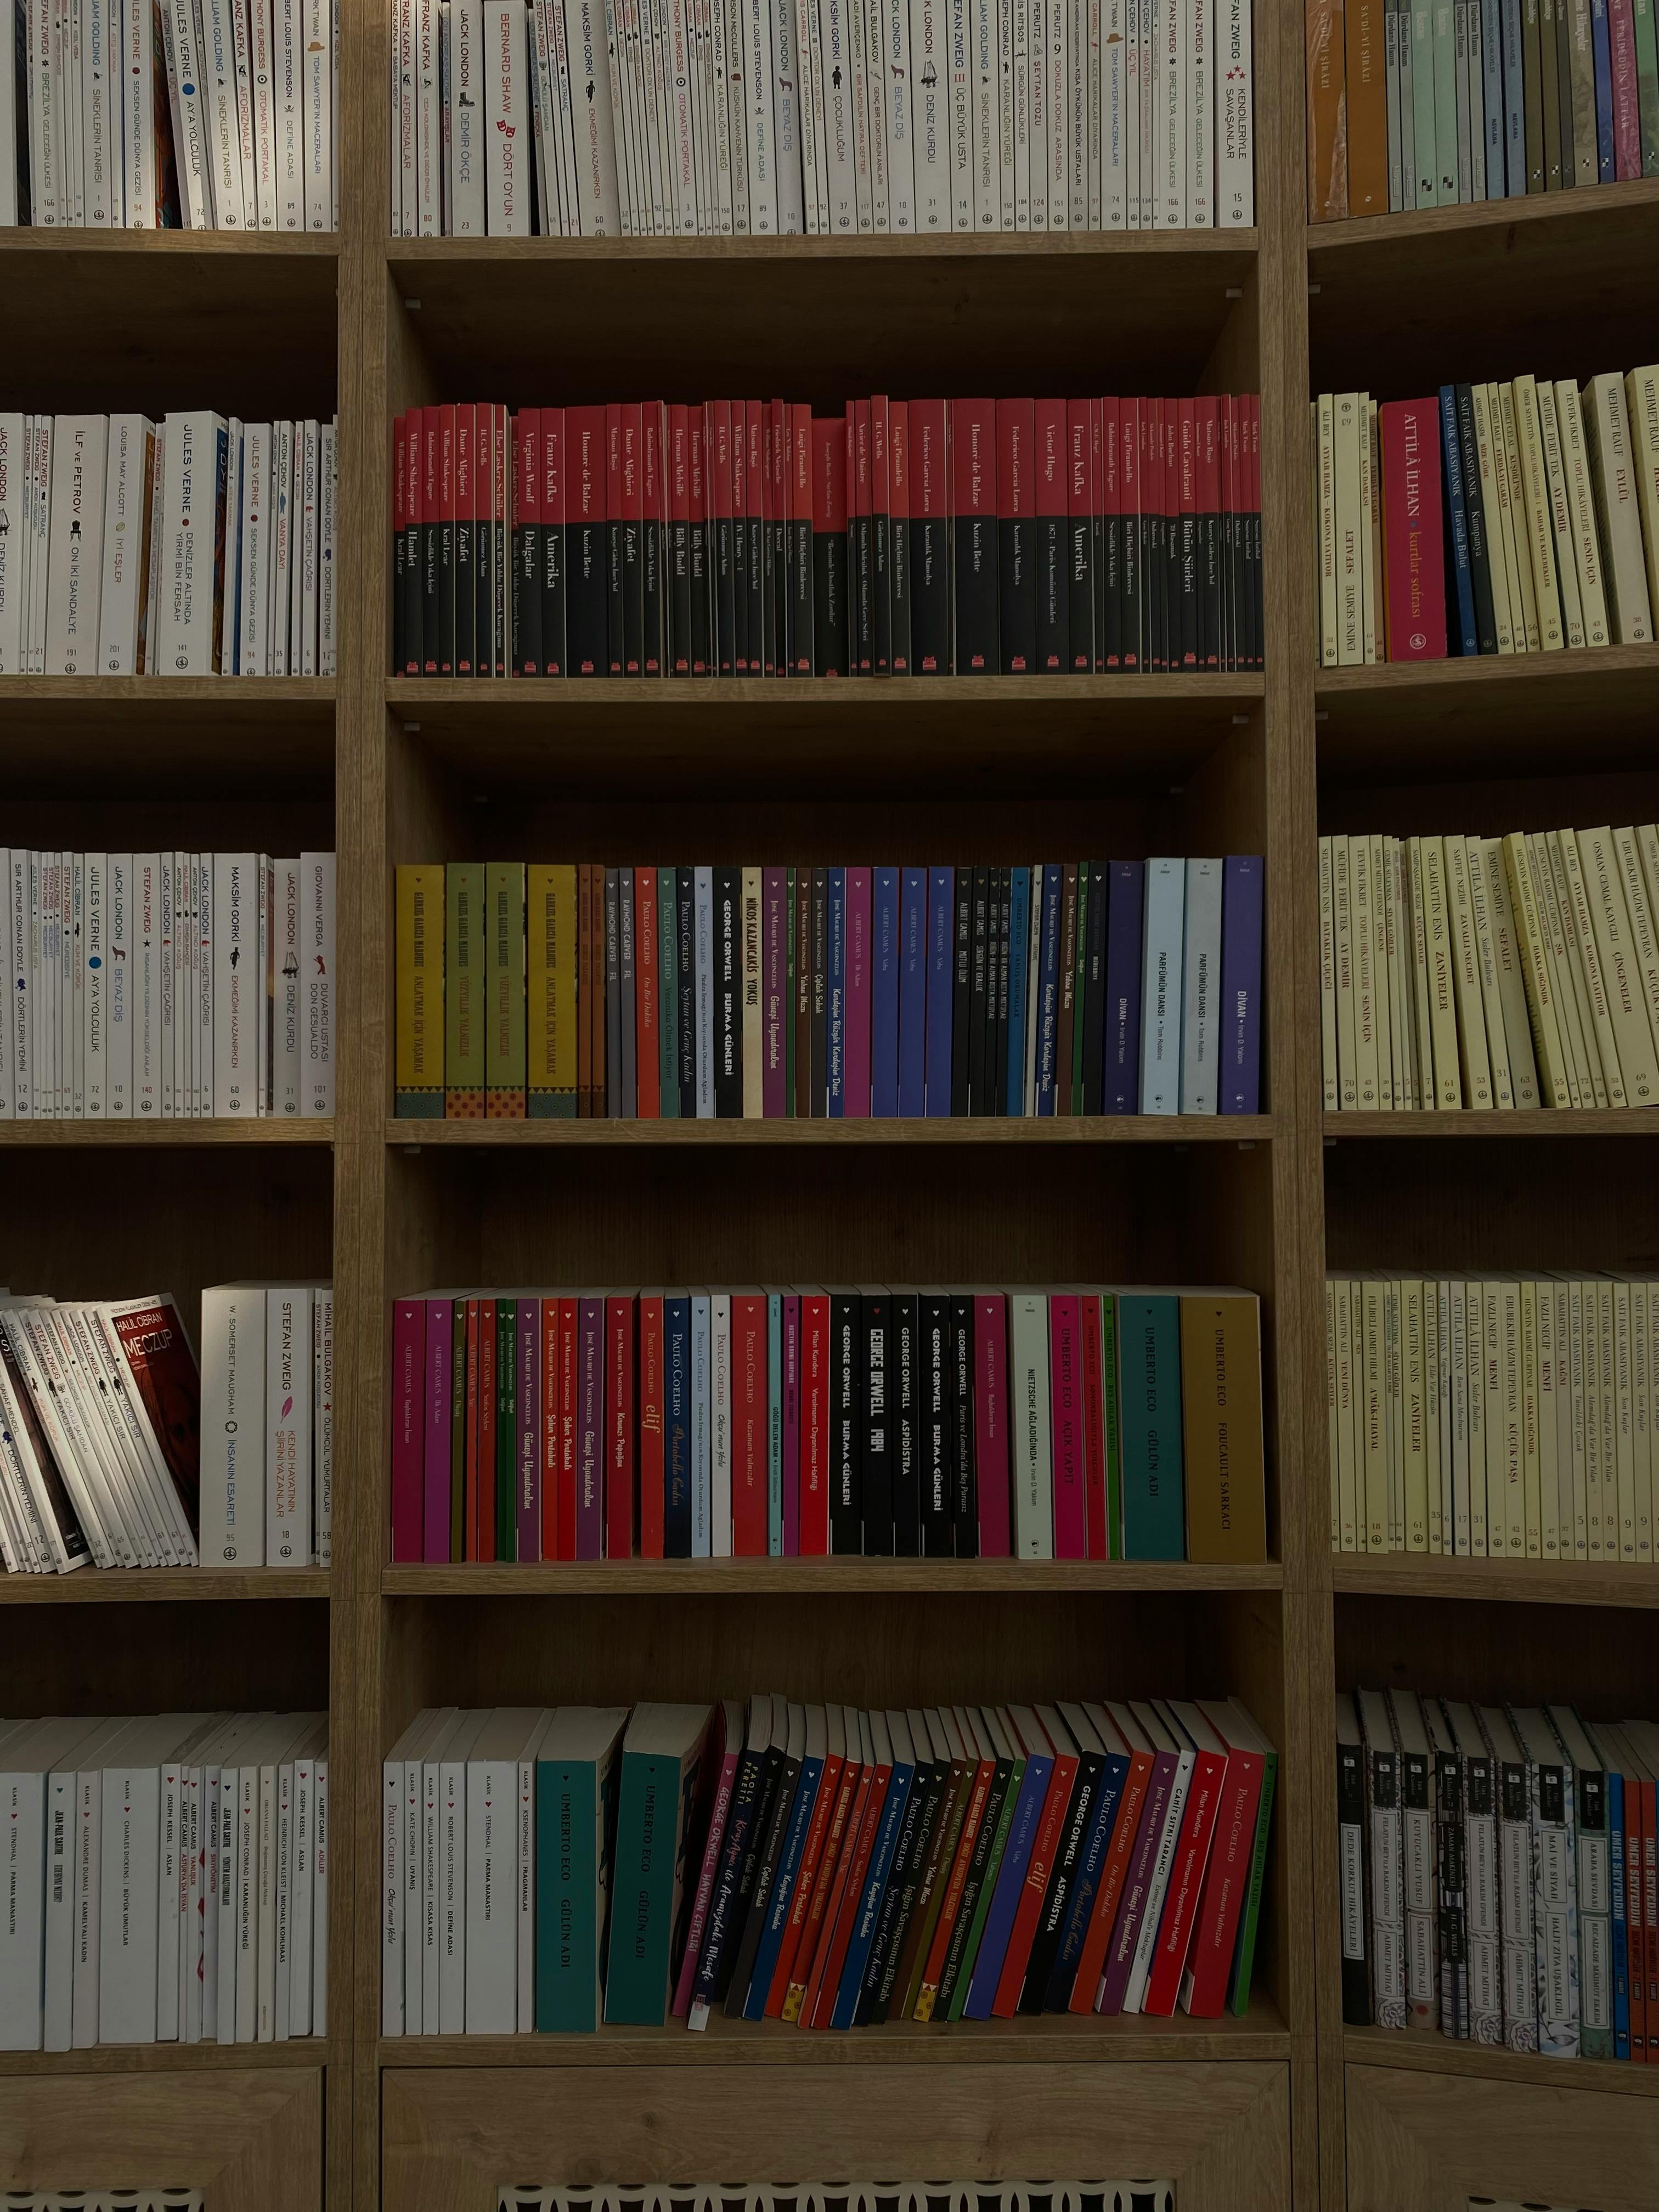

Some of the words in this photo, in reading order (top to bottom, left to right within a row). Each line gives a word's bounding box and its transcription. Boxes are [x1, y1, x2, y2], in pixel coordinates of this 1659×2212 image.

[582, 3, 592, 41] MAKSİM
[924, 12, 933, 53] LONDON
[501, 14, 510, 72] BERNARD
[584, 45, 593, 75] GORKİ
[955, 34, 963, 67] ZWEIG
[502, 77, 511, 112] SHAW
[927, 95, 935, 124] DENİZ
[957, 88, 964, 101] ÜÇ
[461, 113, 469, 147] DEMİR
[589, 109, 597, 145] EKMEĞİMİ
[1225, 89, 1234, 158] SAVAŞANLAR
[1238, 89, 1247, 159] KENDİLERİYLE
[503, 144, 512, 179] DÖRT
[927, 127, 935, 163] KURDU
[461, 151, 470, 183] ÖKÇE
[592, 148, 600, 199] KAZANIRKEN
[504, 182, 513, 216] OYUN
[1234, 193, 1242, 201] 15
[1609, 388, 1620, 427] MEHMET
[76, 431, 85, 448] İLF
[523, 433, 534, 470] Virginia
[547, 435, 556, 466] Franz
[1183, 421, 1191, 449] Guido
[1405, 414, 1420, 466] ATTİLÂ
[1613, 432, 1623, 456] RAUF
[74, 467, 82, 514] PETROV
[183, 470, 191, 512] VERNE
[526, 474, 535, 504] Woolf
[548, 471, 557, 502] Kafka
[1183, 452, 1192, 500] Cavalcanti
[1407, 470, 1420, 516] İLHAN
[1617, 469, 1628, 503] EYLÜL
[71, 548, 78, 561] ON
[522, 531, 535, 578] Dalgalar
[1184, 521, 1193, 552] Bütün
[1409, 532, 1422, 574] kurtlar
[71, 566, 80, 577] İKİ
[547, 531, 559, 588] Amerika
[1182, 556, 1194, 592] Şiirleri
[69, 580, 77, 634] SANDALYE
[1346, 586, 1355, 618] SEMİYE
[1411, 578, 1423, 617] sofrası
[1346, 623, 1355, 651] EMİNE
[91, 867, 99, 905] JULES
[1429, 853, 1441, 912] SELAHATTİN
[746, 898, 758, 920] NİKOS
[91, 910, 99, 951] VERNE
[1433, 918, 1443, 940] ENİS
[724, 941, 732, 981] ORWELL
[747, 923, 759, 972] KAZANCAKİS
[1159, 952, 1167, 992] PARFÜMÜN
[1436, 952, 1448, 1009] ZANİYELER
[746, 979, 757, 1005] YOKUŞ
[724, 993, 732, 1031] BURMA
[725, 1033, 733, 1075] GÜNLERİ
[116, 1317, 138, 1332] HALİL
[137, 1312, 163, 1327] CİBRAN
[1489, 1323, 1497, 1348] NECİP
[123, 1329, 172, 1358] MECZUP
[871, 1329, 884, 1368] GEORGE
[1146, 1328, 1155, 1384] UMBERTO
[1216, 1330, 1225, 1380] UMBERTO
[283, 1353, 291, 1390] ZWEIG
[1490, 1360, 1498, 1389] MENFİ
[871, 1370, 884, 1417] ORWELL
[1147, 1390, 1156, 1412] ECO
[1217, 1386, 1226, 1406] ECO
[642, 1405, 660, 1433] elif
[1029, 1411, 1037, 1460] AĞLADIĞINDA
[288, 1431, 296, 1459] KENDİ
[871, 1427, 884, 1452] 1984
[1148, 1430, 1159, 1470] GÜLÜN
[1218, 1423, 1228, 1477] FOUCAULT
[228, 1440, 236, 1479] İNSANIN
[1149, 1475, 1158, 1496] ADI
[1221, 1482, 1230, 1529] SARKACI
[1075, 1786, 1091, 1825] GEORGE
[1172, 1789, 1182, 1813] CAHİT
[1167, 1816, 1176, 1837] SITKI
[1064, 1827, 1080, 1866] ORWELL
[1158, 1839, 1172, 1875] TARANCI
[1046, 1876, 1066, 1931] ASPİDİSTRA
[1418, 1921, 1426, 1976] SABAHATTİN
